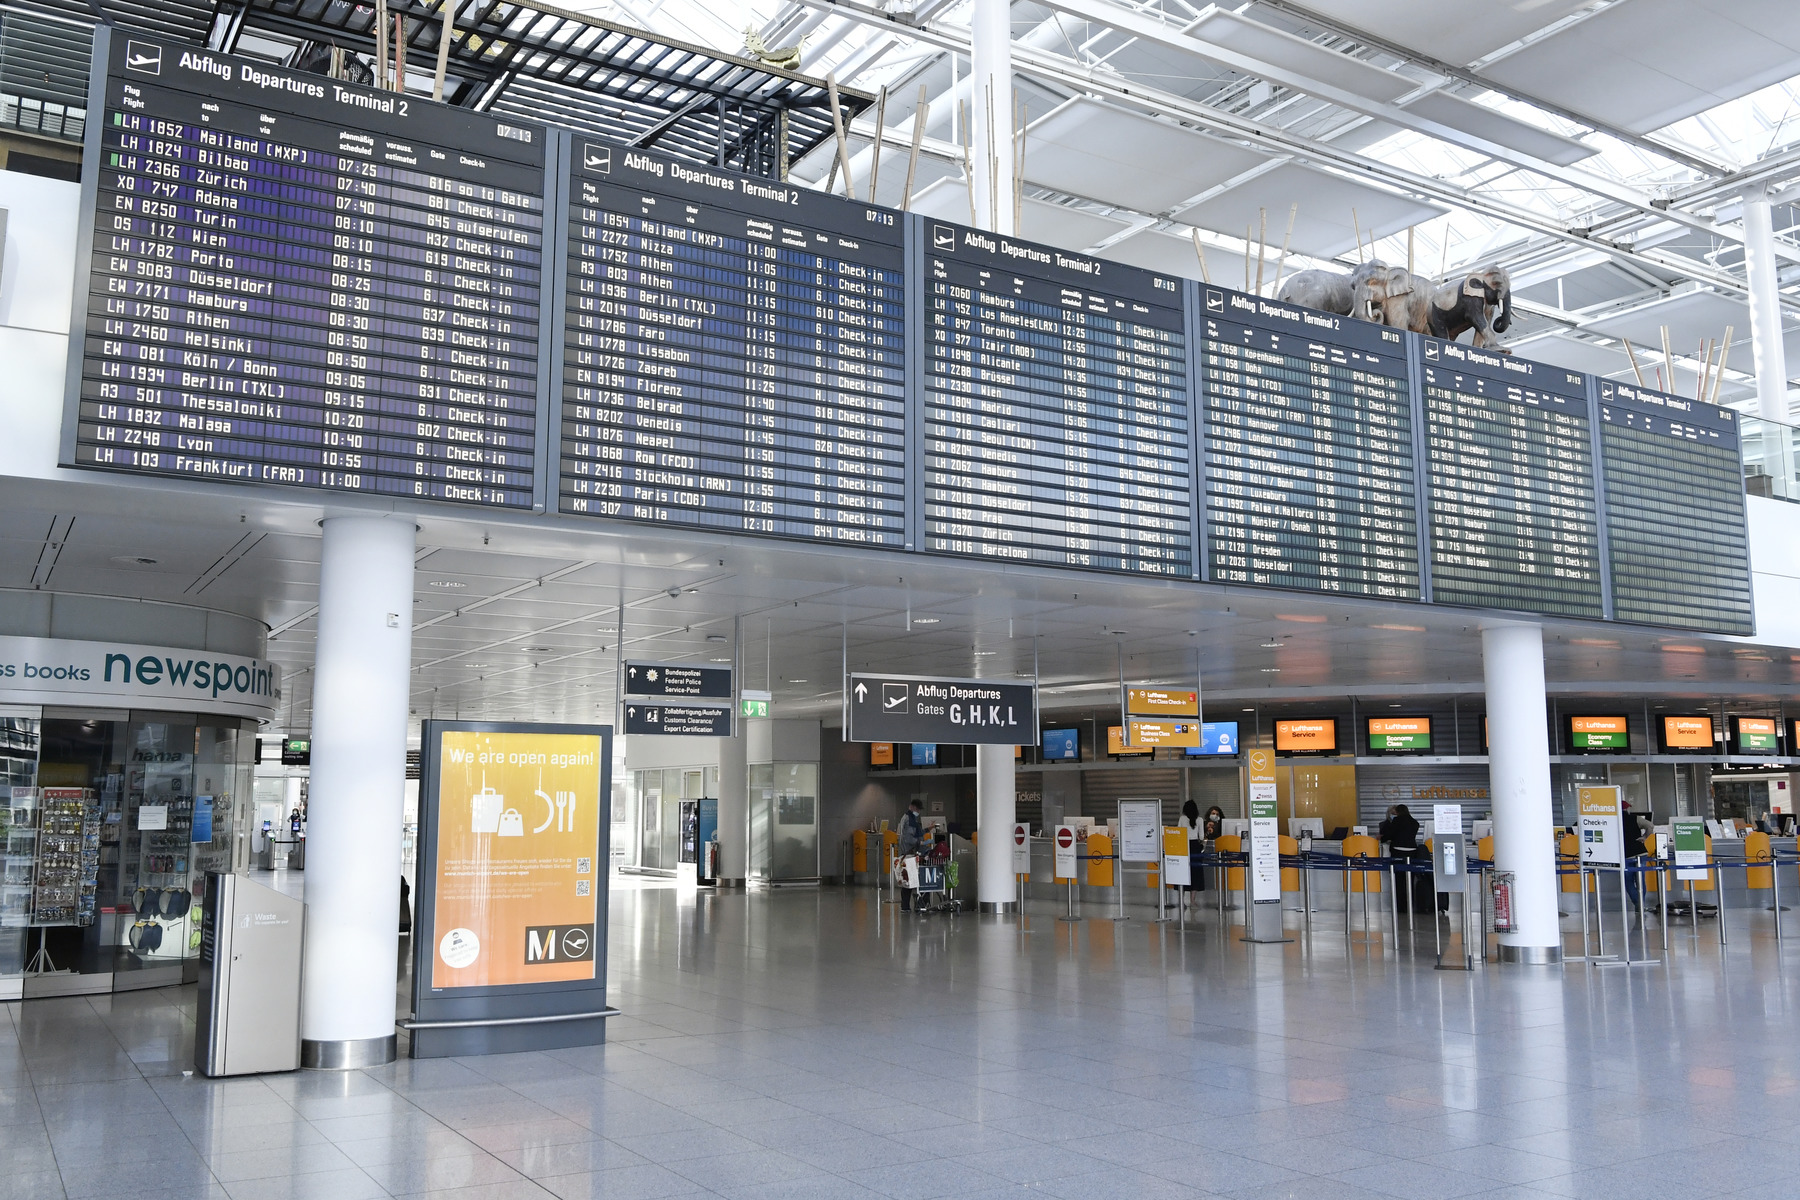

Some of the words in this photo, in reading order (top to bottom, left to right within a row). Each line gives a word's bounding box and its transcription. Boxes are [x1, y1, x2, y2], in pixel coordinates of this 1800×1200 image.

[180, 52, 231, 80] Abflug
[242, 66, 324, 97] Departures
[333, 86, 394, 113] Terminal
[399, 101, 408, 116] 2
[124, 85, 140, 96] Flug
[202, 104, 219, 112] nach
[260, 114, 276, 124] über
[340, 132, 374, 146] planmäßig
[431, 150, 445, 159] Gate
[124, 97, 144, 108] Flight
[340, 144, 372, 155] scheduled
[386, 154, 416, 164] estimated
[498, 124, 530, 142] 07:13
[121, 134, 138, 149] LH
[149, 140, 181, 158] 1824
[199, 150, 248, 170] Bilbao
[338, 178, 376, 196] 07:40
[458, 202, 514, 223] Check-in
[584, 183, 595, 193] Flug
[624, 153, 663, 176] Abflug
[672, 164, 734, 190] Departures
[740, 180, 787, 202] Terminal
[792, 192, 798, 204] 2
[120, 155, 136, 170] LH
[146, 160, 179, 178] 2366
[198, 170, 246, 190] Zürich
[336, 196, 374, 214] 07:40
[458, 222, 527, 244] aufgerufen
[583, 194, 598, 203] Flight
[118, 175, 134, 190] XQ
[152, 182, 178, 197] 747
[196, 190, 237, 208] Adana
[336, 216, 373, 233] 08:10
[427, 232, 448, 248] H32
[456, 238, 512, 259] Check-in
[867, 210, 892, 225] 07:13
[965, 232, 995, 253] Abflug
[1002, 241, 1050, 263] Departures
[1055, 254, 1092, 273] Terminal
[1095, 263, 1100, 275] 2
[582, 262, 594, 274] A3
[608, 267, 627, 280] 803
[640, 273, 672, 289] Athen
[748, 294, 775, 308] 11:15
[839, 311, 882, 329] Check-in
[1231, 296, 1256, 313] Abflug
[1260, 302, 1299, 320] Departures
[1303, 312, 1332, 328] Terminal
[1334, 320, 1339, 330] 2
[981, 323, 1014, 339] Toronto
[1064, 340, 1085, 353] 12:55
[1134, 354, 1168, 369] Check-in
[1445, 345, 1464, 360] Abflug
[1468, 350, 1500, 366] Departures
[1502, 358, 1526, 372] Terminal
[1528, 364, 1532, 374] 2
[1311, 362, 1328, 374] 15:50
[1368, 374, 1395, 388] Check-in
[1618, 386, 1634, 400] Abflug
[1637, 390, 1664, 405] Departures
[1666, 398, 1686, 410] Terminal
[1687, 402, 1690, 411] 2
[100, 384, 118, 398] A3
[137, 388, 160, 403] 501
[182, 394, 280, 418] Thessaloniki
[326, 412, 362, 428] 10:20
[448, 427, 506, 445] Check-in
[574, 498, 586, 511] KM
[601, 502, 620, 514] 307
[634, 506, 666, 520] Malta
[744, 518, 772, 531] 12:10
[838, 528, 882, 542] Check-in
[24, 662, 90, 681] books
[104, 653, 273, 698] newspoint
[665, 669, 701, 678] Bundespolizei
[917, 684, 948, 700] Abflug
[950, 686, 1000, 700] Departures
[917, 703, 944, 715] Gates
[950, 704, 966, 726] G,
[970, 705, 986, 726] H,
[989, 706, 1005, 726] K,
[1008, 706, 1018, 725] L
[132, 748, 182, 761] hama
[450, 748, 474, 764] We
[480, 752, 504, 764] are
[510, 752, 546, 770] open
[550, 752, 594, 769] again!
[1015, 792, 1042, 802] Tickets
[1412, 785, 1487, 798] Lufthansa
[1582, 804, 1616, 812] Lufthansa
[528, 930, 556, 961] M
